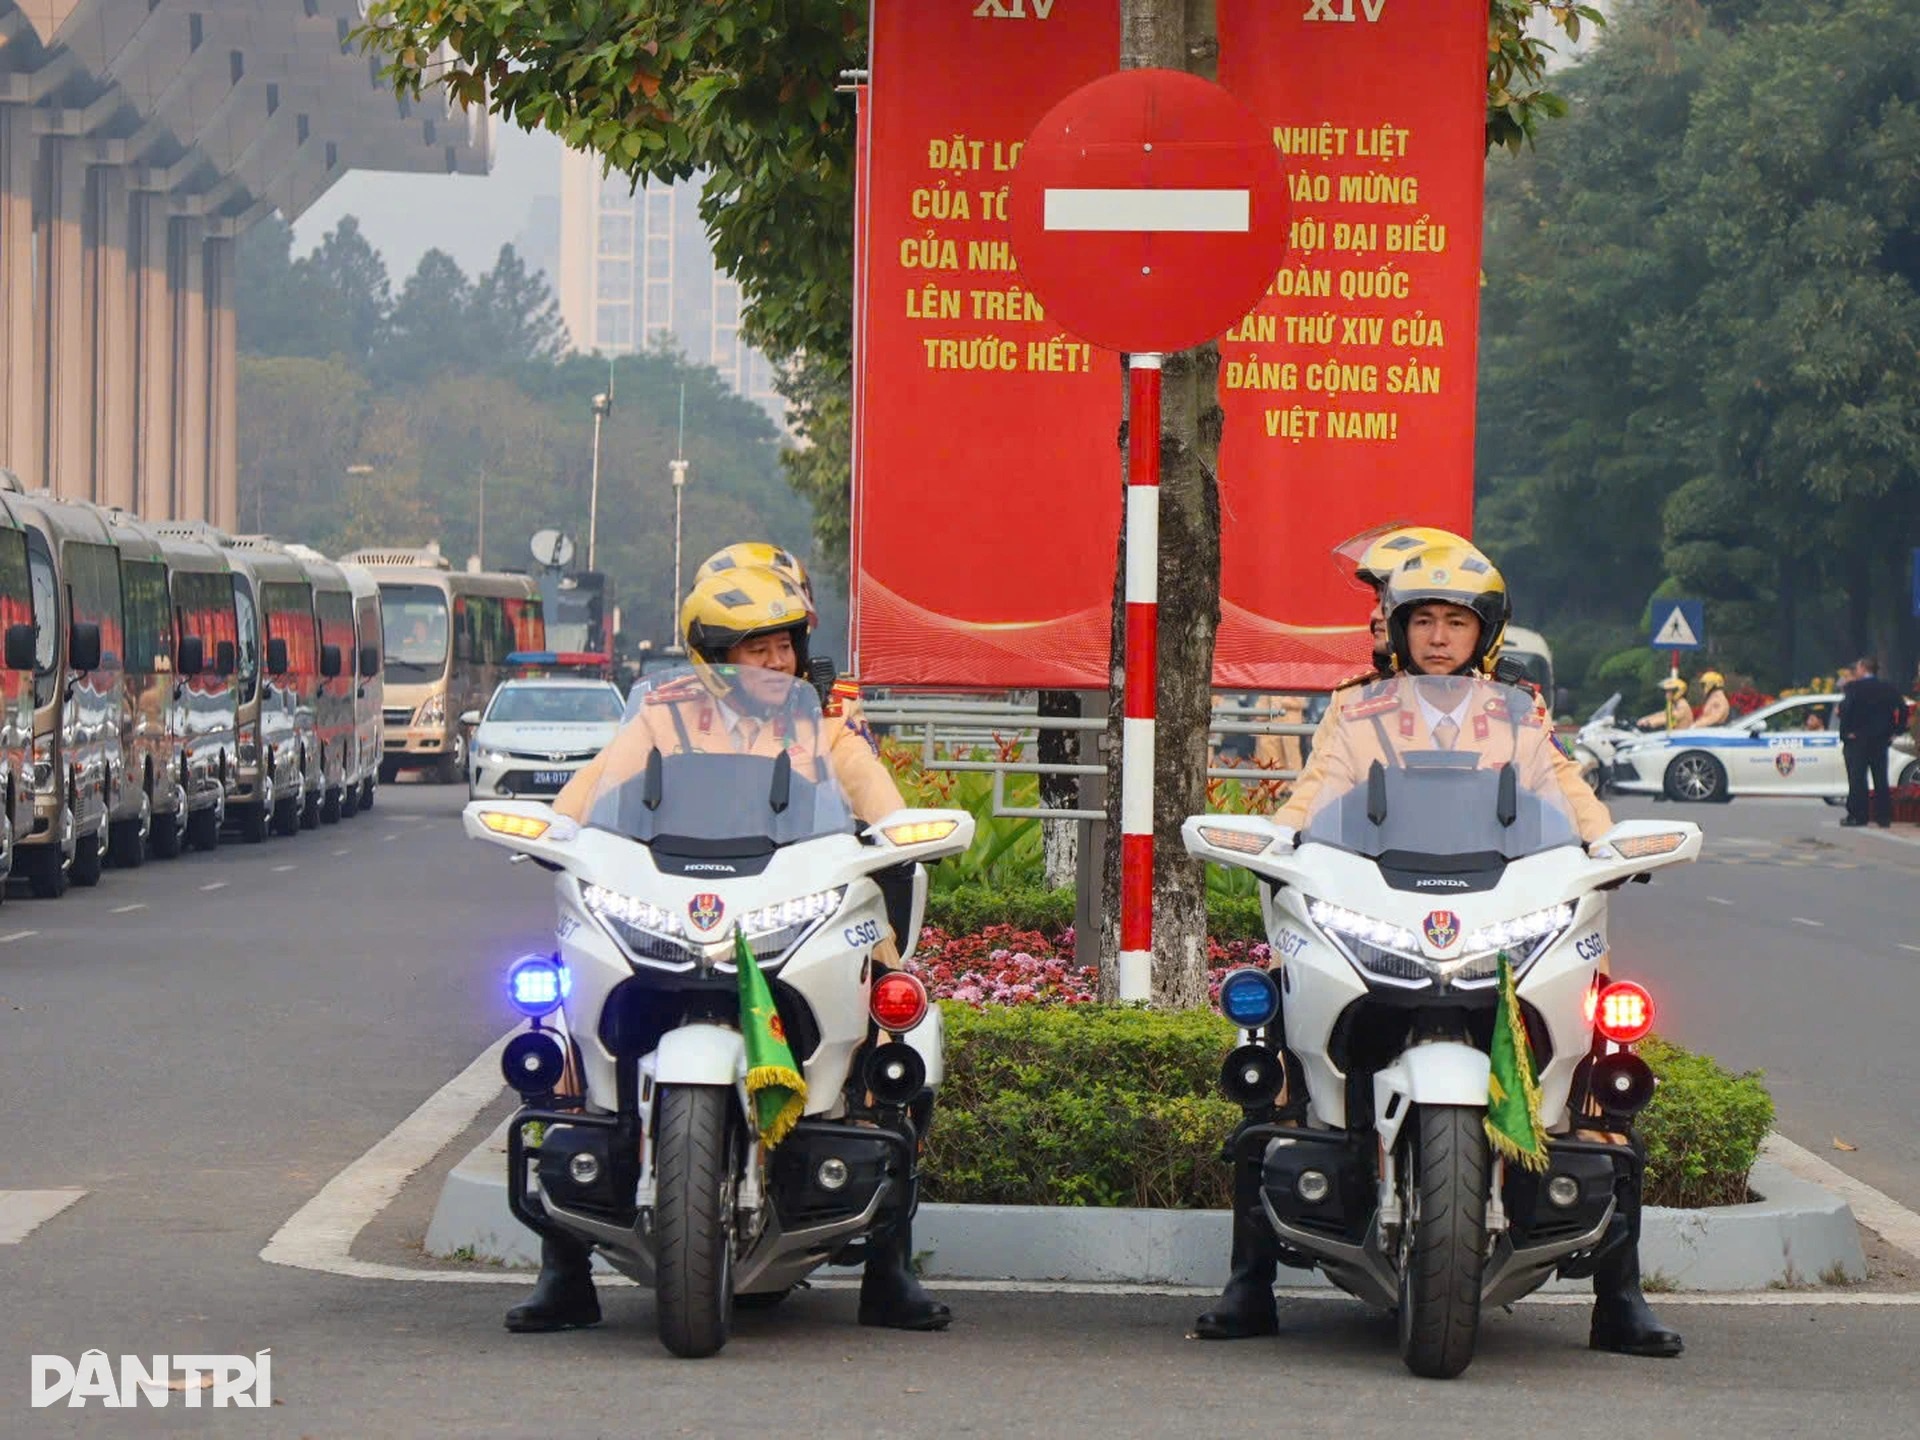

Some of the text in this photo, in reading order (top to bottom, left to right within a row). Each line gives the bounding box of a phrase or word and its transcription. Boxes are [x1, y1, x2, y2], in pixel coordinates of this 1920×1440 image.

[928, 134, 985, 176] ĐẶT
[1273, 121, 1410, 162] NHIỆT LIỆT
[912, 179, 970, 220] CỦA
[1339, 170, 1418, 205] MỪNG
[900, 229, 959, 270] CỦA
[1332, 223, 1377, 257] ĐẠI
[1386, 213, 1446, 253] BIỂU
[1266, 261, 1409, 301] OÀN QUỐC
[906, 282, 1044, 322] LÊN TRÊN
[1283, 311, 1337, 345] THỨ
[1340, 317, 1384, 346] XIV
[1391, 309, 1444, 348] CỦA
[923, 333, 1090, 373] TRƯỚC HẾT!
[1226, 352, 1441, 398] ĐẢNG CỘNG SẢN
[1264, 404, 1397, 444] VIỆT NAM!
[683, 863, 736, 872] HONDA
[1416, 878, 1470, 888] HONDA
[1274, 927, 1309, 957] CSGT
